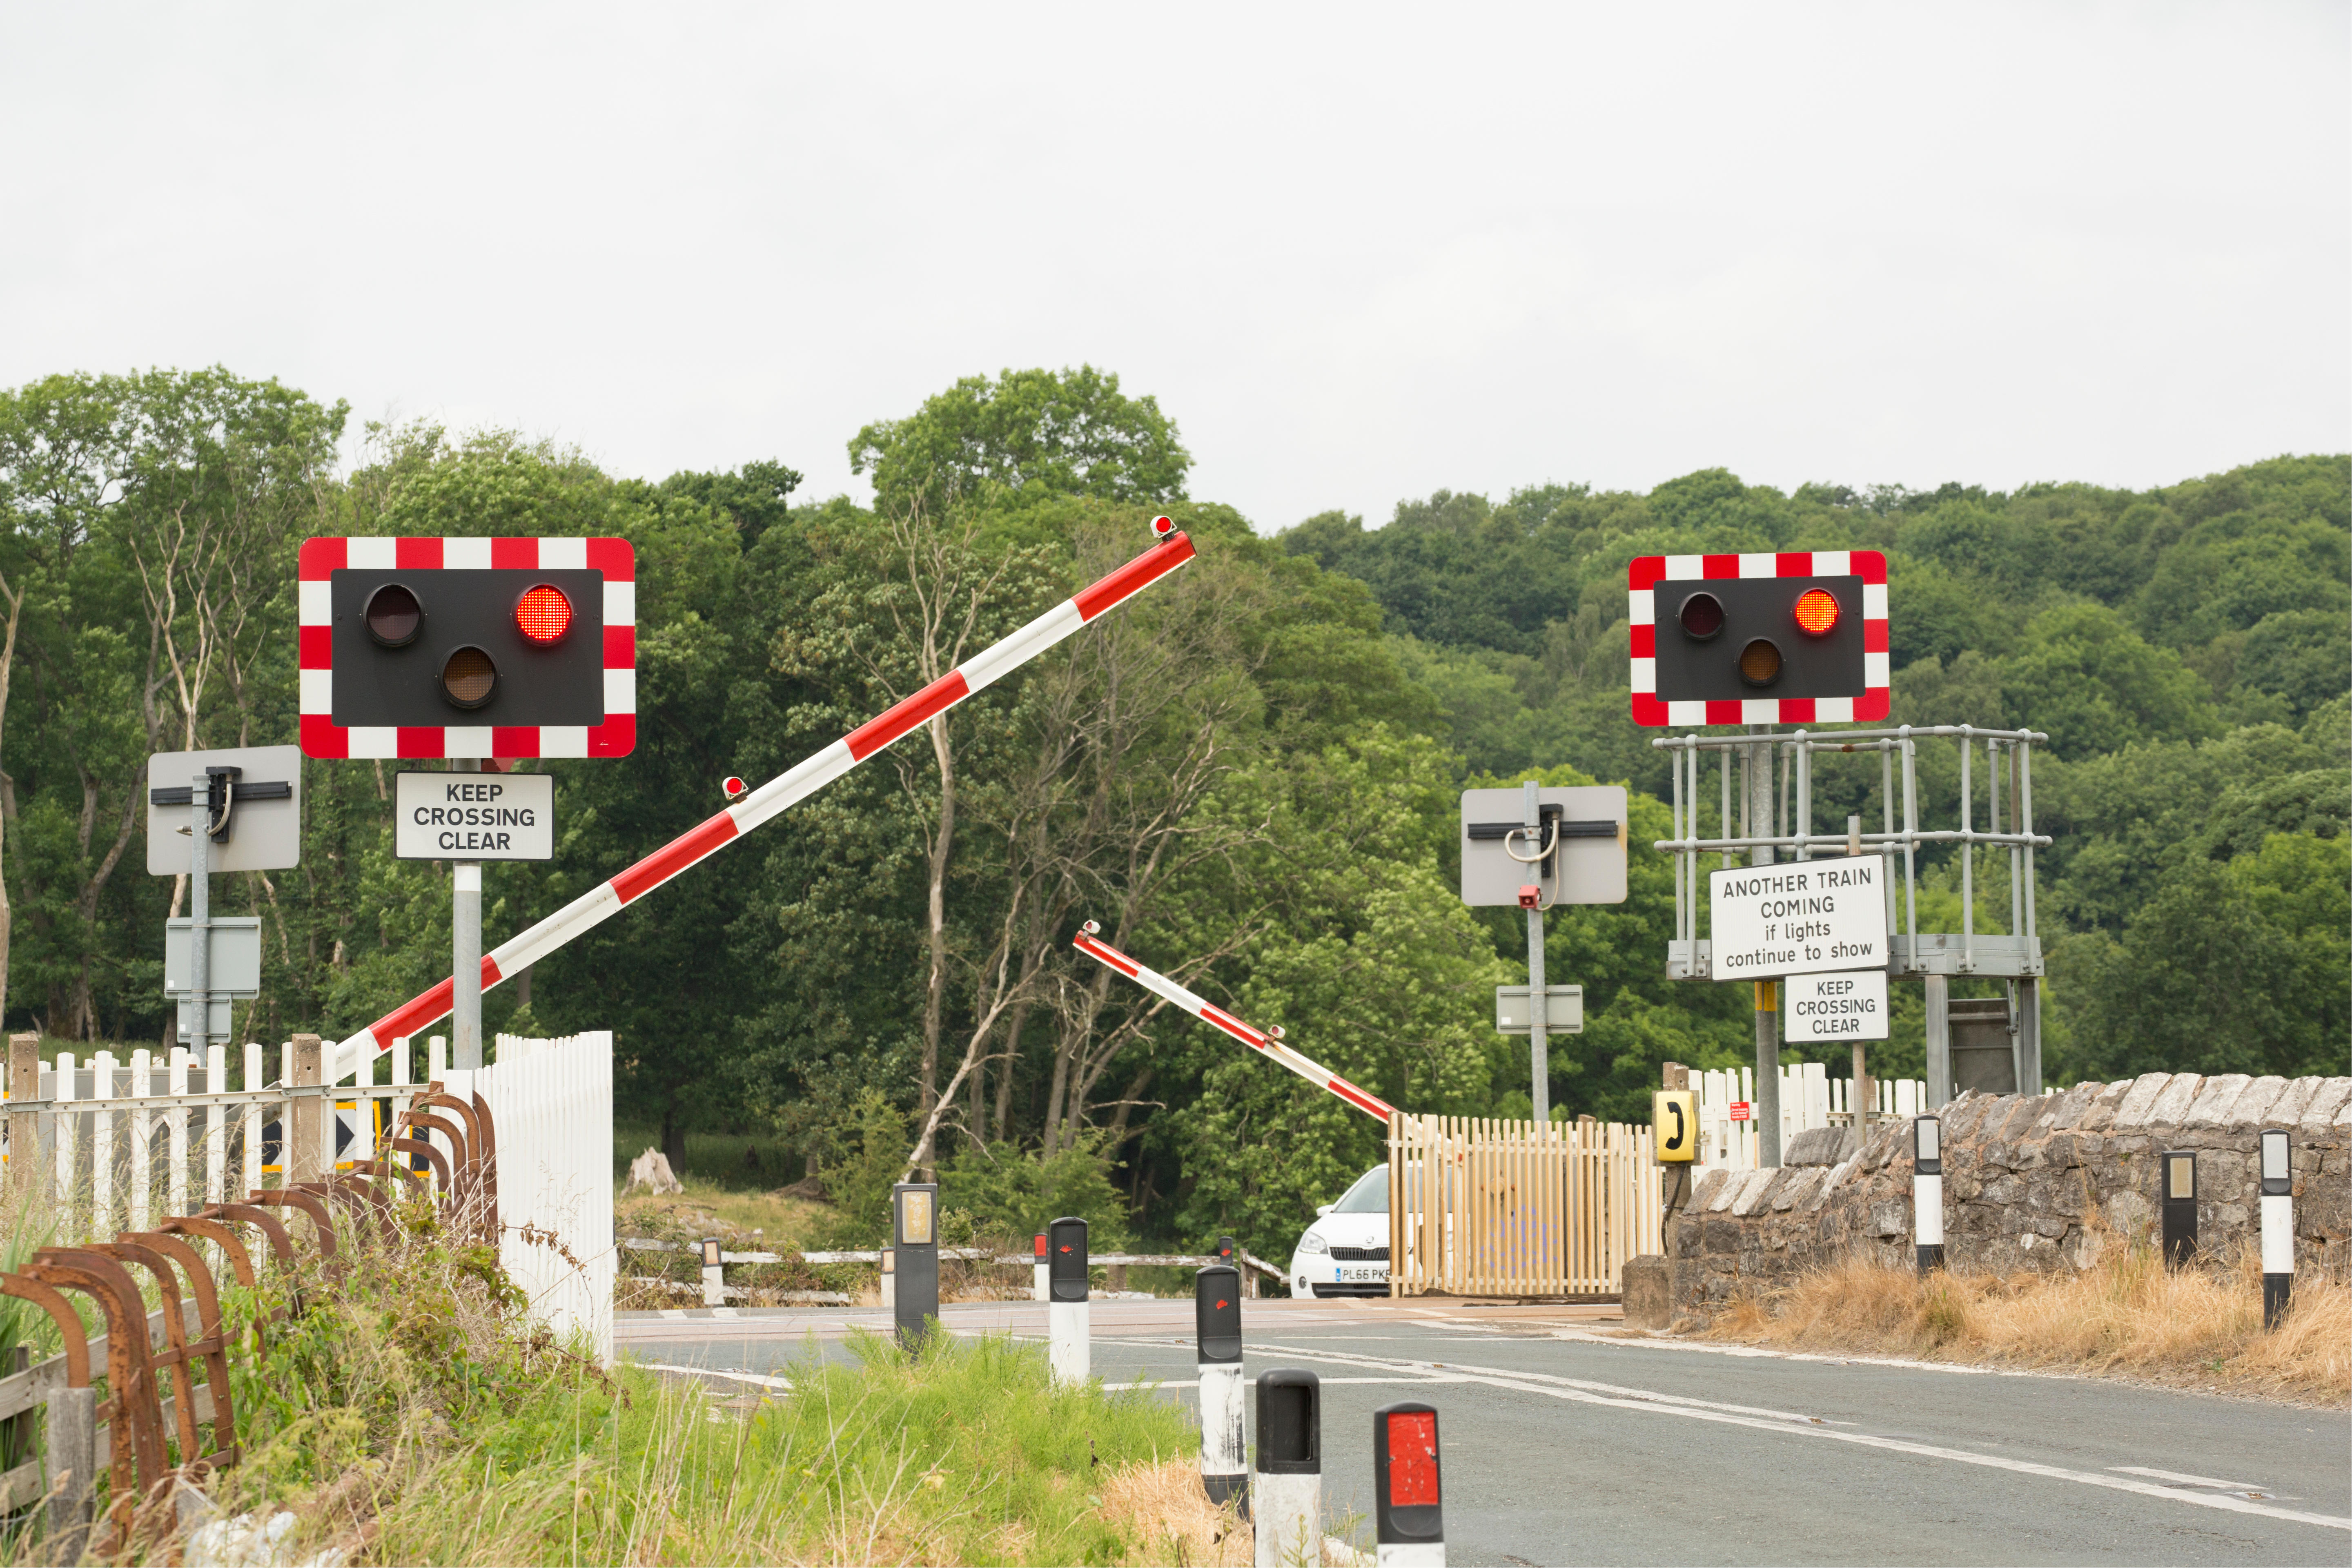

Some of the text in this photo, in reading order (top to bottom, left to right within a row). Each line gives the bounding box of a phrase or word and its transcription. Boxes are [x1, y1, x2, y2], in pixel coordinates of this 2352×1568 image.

[447, 784, 503, 802] KEEP
[414, 807, 535, 826] CROSSING
[439, 831, 510, 850] CLEAR
[1724, 868, 1871, 898] ANOTHER TRAIN
[1761, 896, 1834, 918] COMING
[1766, 921, 1830, 942] if lights
[1726, 941, 1872, 967] continue to show
[1817, 980, 1853, 996] KEEP
[1797, 999, 1875, 1016] CROSSING
[1813, 1018, 1859, 1034] CLEAR
[1343, 1269, 1369, 1279] PL66
